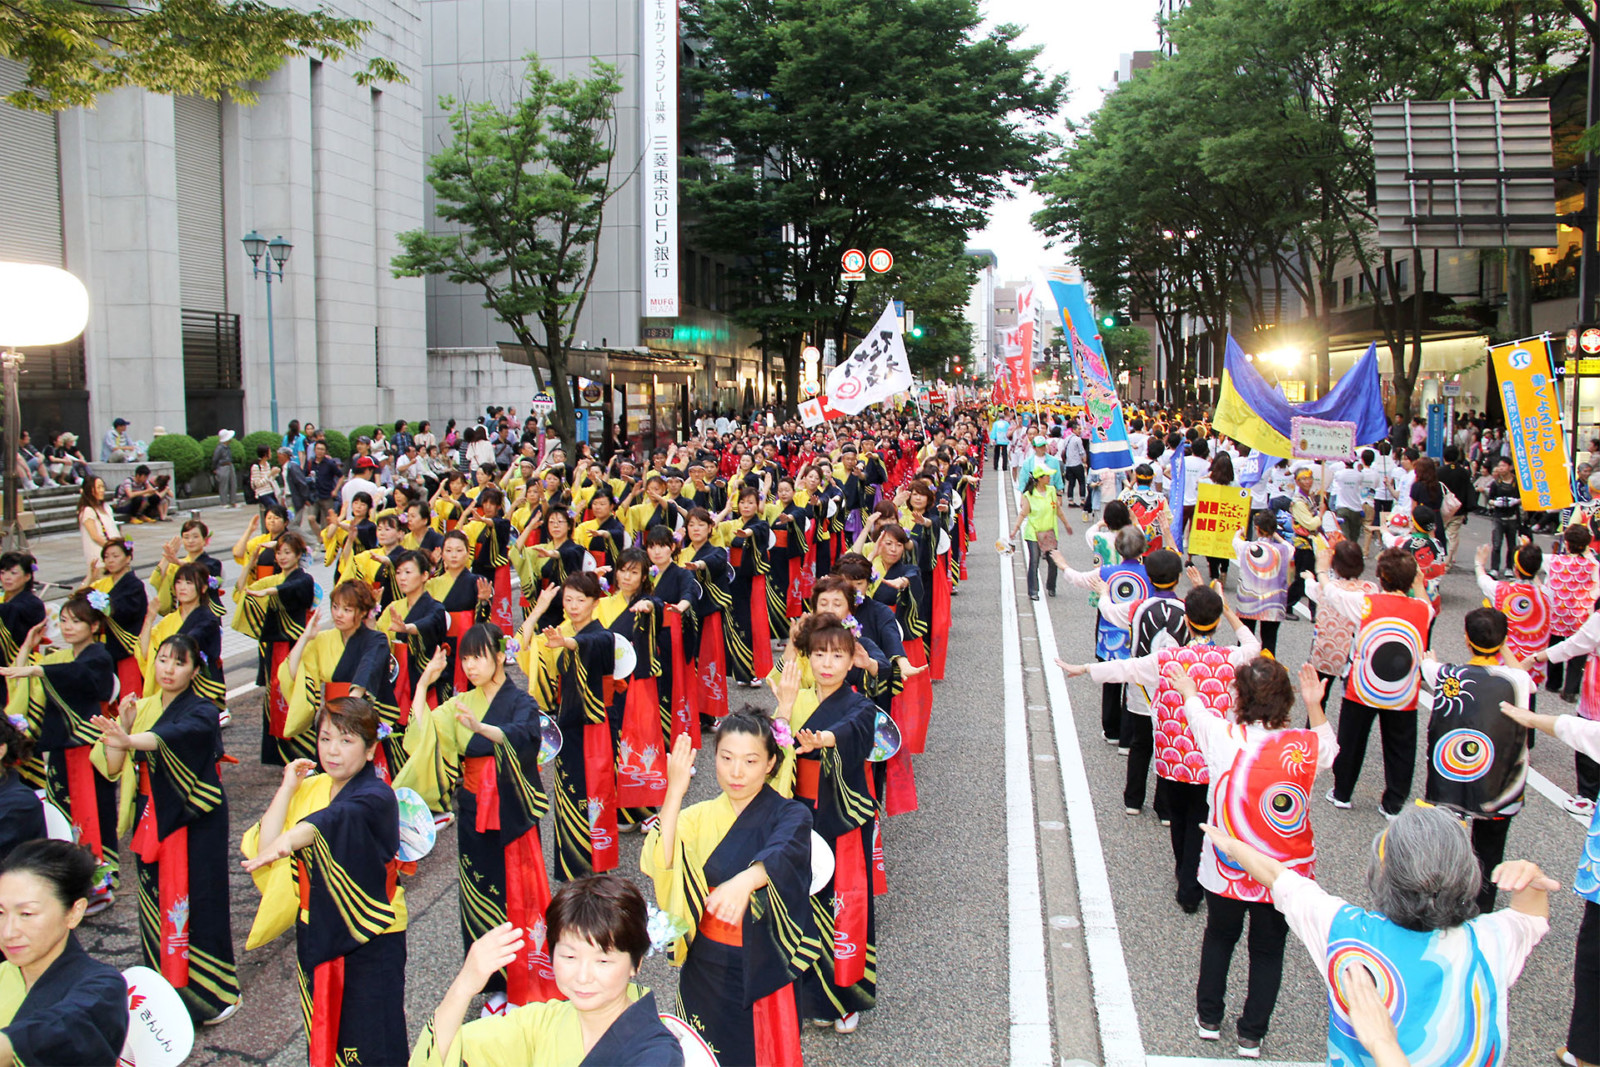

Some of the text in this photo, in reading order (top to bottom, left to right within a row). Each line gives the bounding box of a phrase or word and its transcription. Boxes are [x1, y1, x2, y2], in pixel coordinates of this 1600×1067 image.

[653, 135, 669, 278] 三菱東京UFJ銀行
[875, 256, 887, 266] 40
[140, 1009, 173, 1054] きんしん
